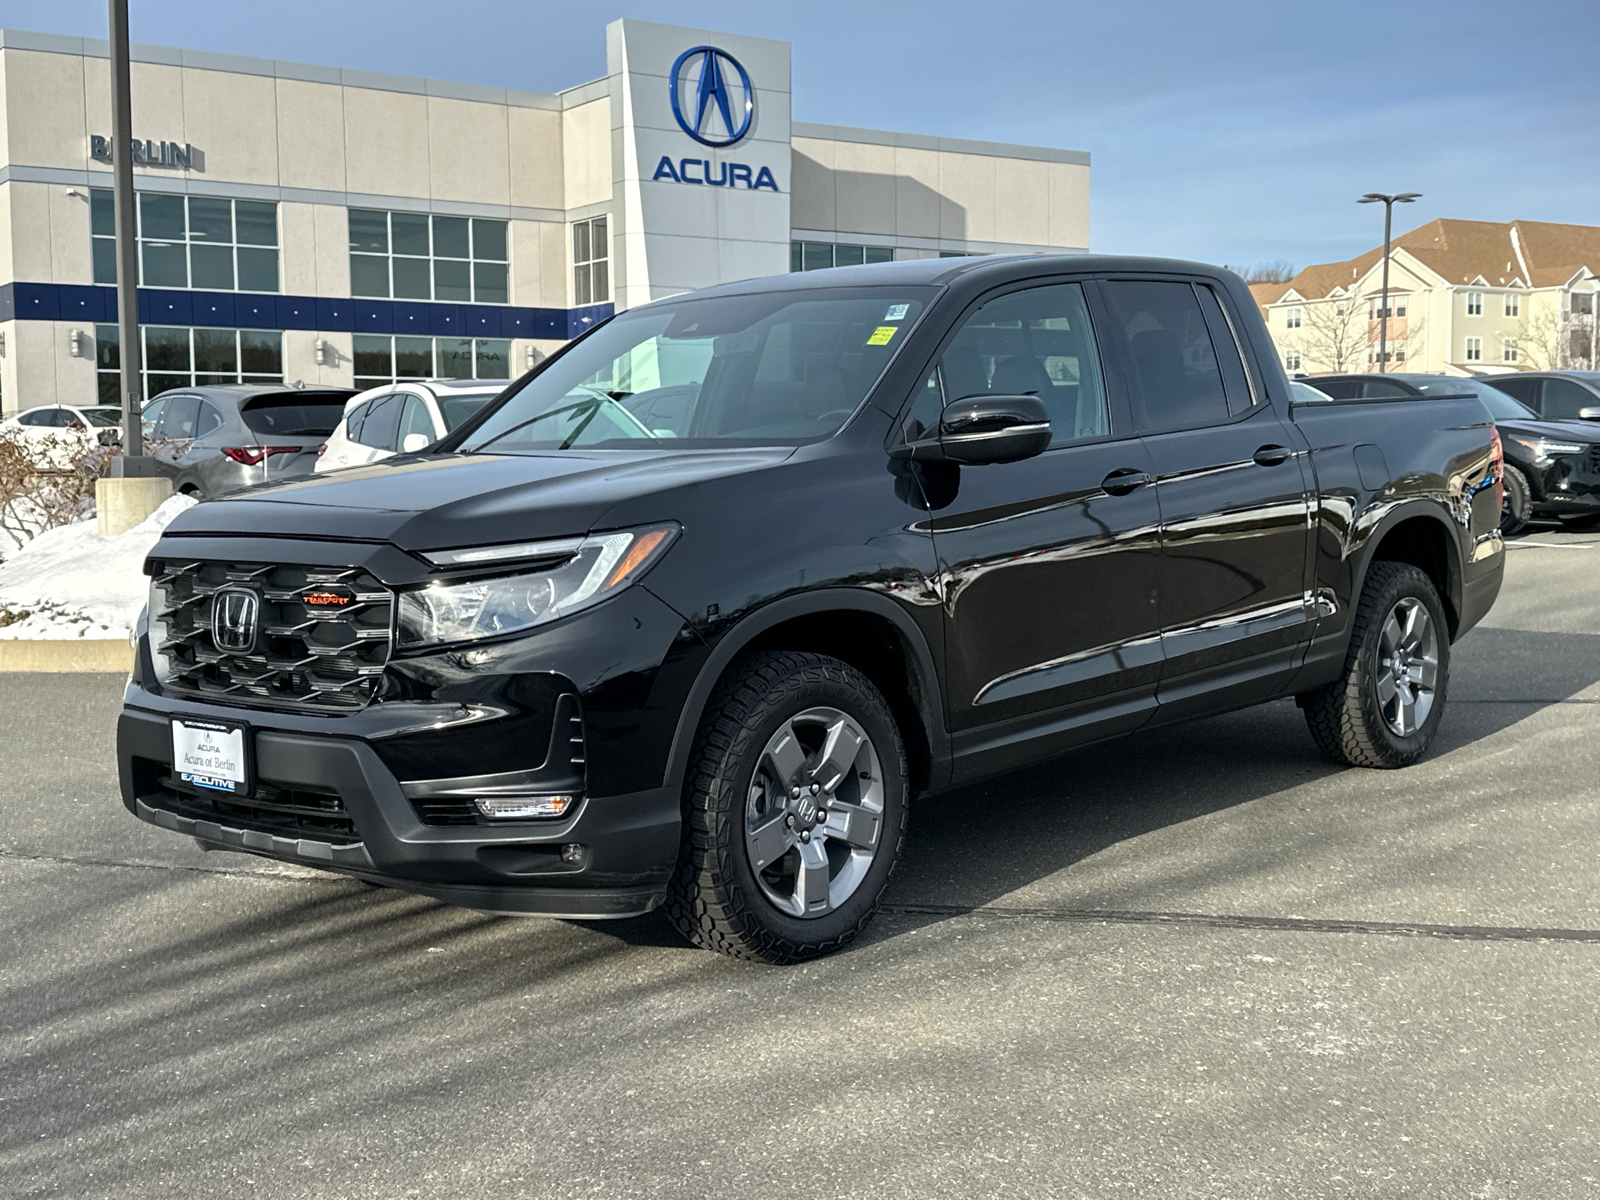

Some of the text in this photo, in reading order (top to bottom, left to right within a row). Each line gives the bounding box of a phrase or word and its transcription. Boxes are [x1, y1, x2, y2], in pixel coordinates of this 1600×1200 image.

[91, 135, 191, 167] BRLIN
[652, 156, 779, 192] ACURA
[197, 744, 221, 754] ACURA
[184, 753, 235, 771] Acura of Berlin
[181, 773, 236, 789] EXECUTIVE
